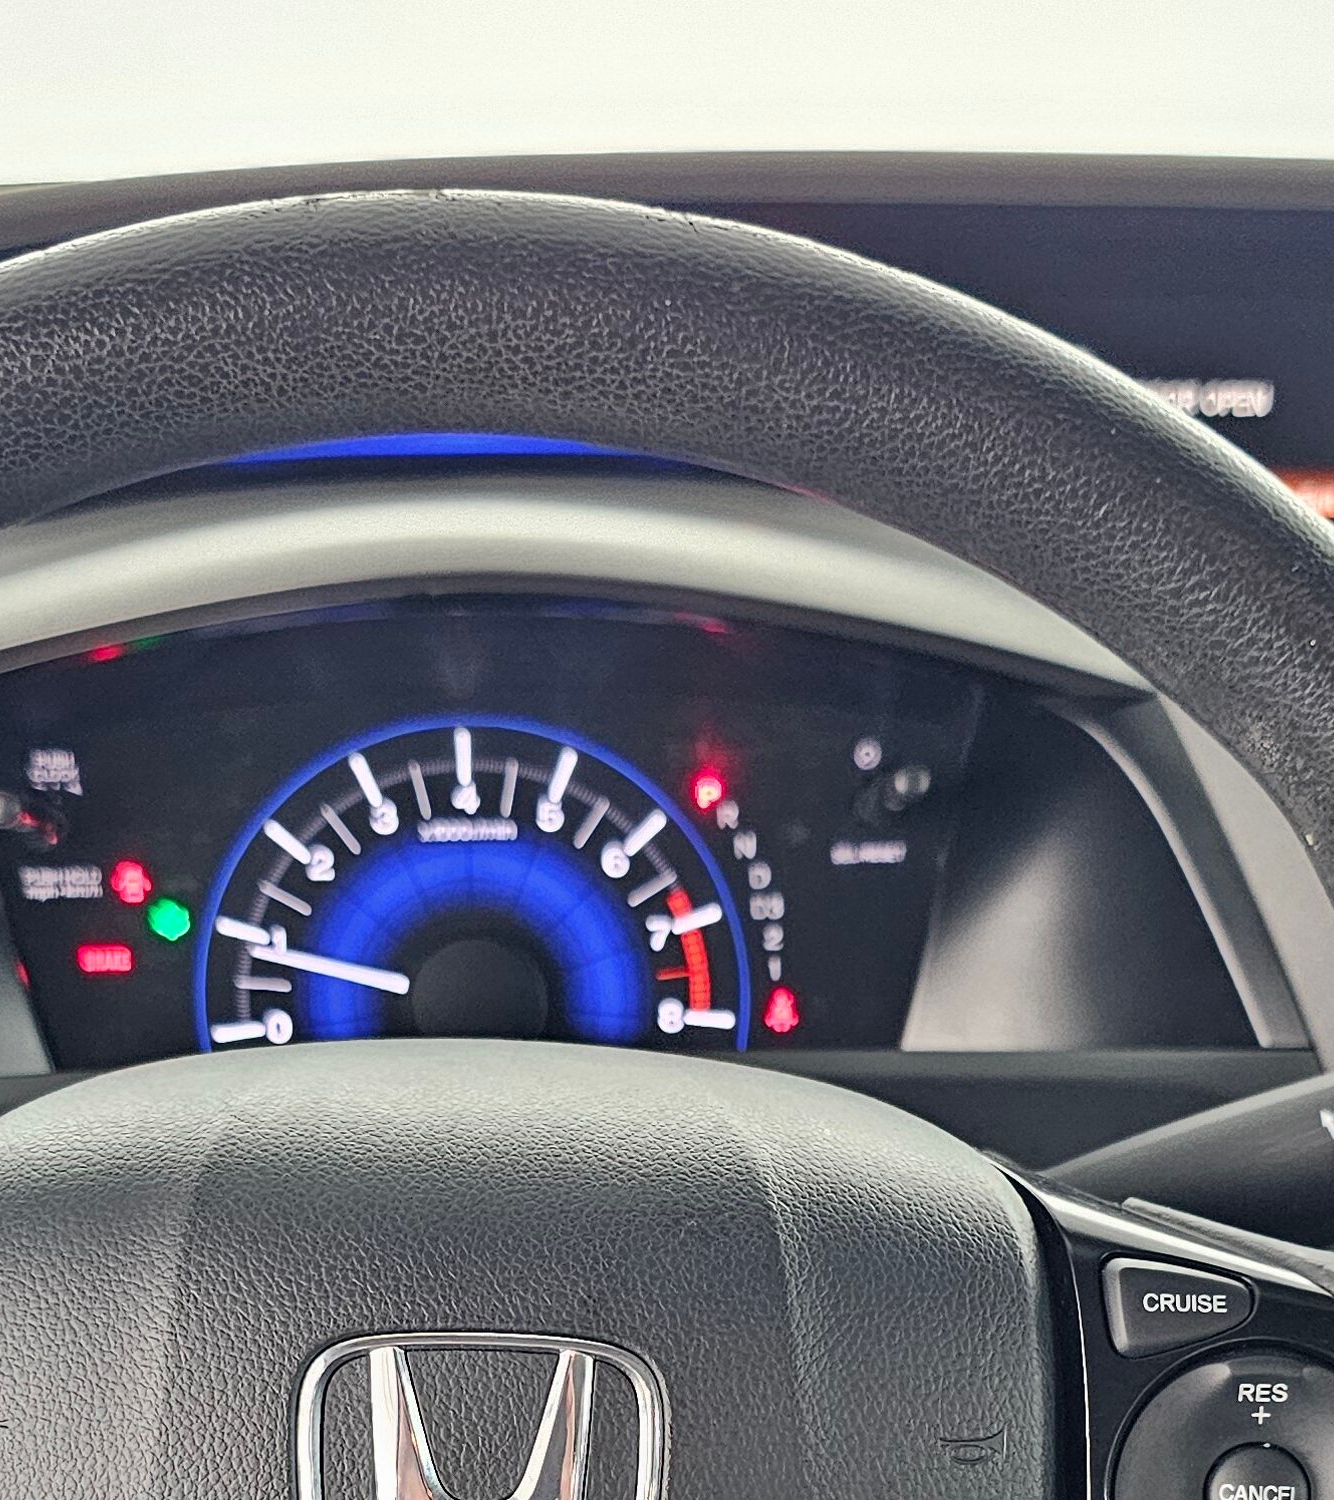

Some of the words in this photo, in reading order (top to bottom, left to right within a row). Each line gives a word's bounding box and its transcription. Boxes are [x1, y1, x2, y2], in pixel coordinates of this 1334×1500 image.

[451, 778, 480, 815] 4
[535, 796, 565, 833] 5
[369, 798, 399, 836] 3
[305, 843, 336, 882] 2
[599, 840, 631, 880] 6
[269, 923, 288, 954] 1
[644, 914, 672, 951] 7
[264, 1008, 294, 1046] 0
[658, 997, 685, 1034] 8
[1142, 1291, 1228, 1314] CRUISE
[1237, 1383, 1289, 1403] RES
